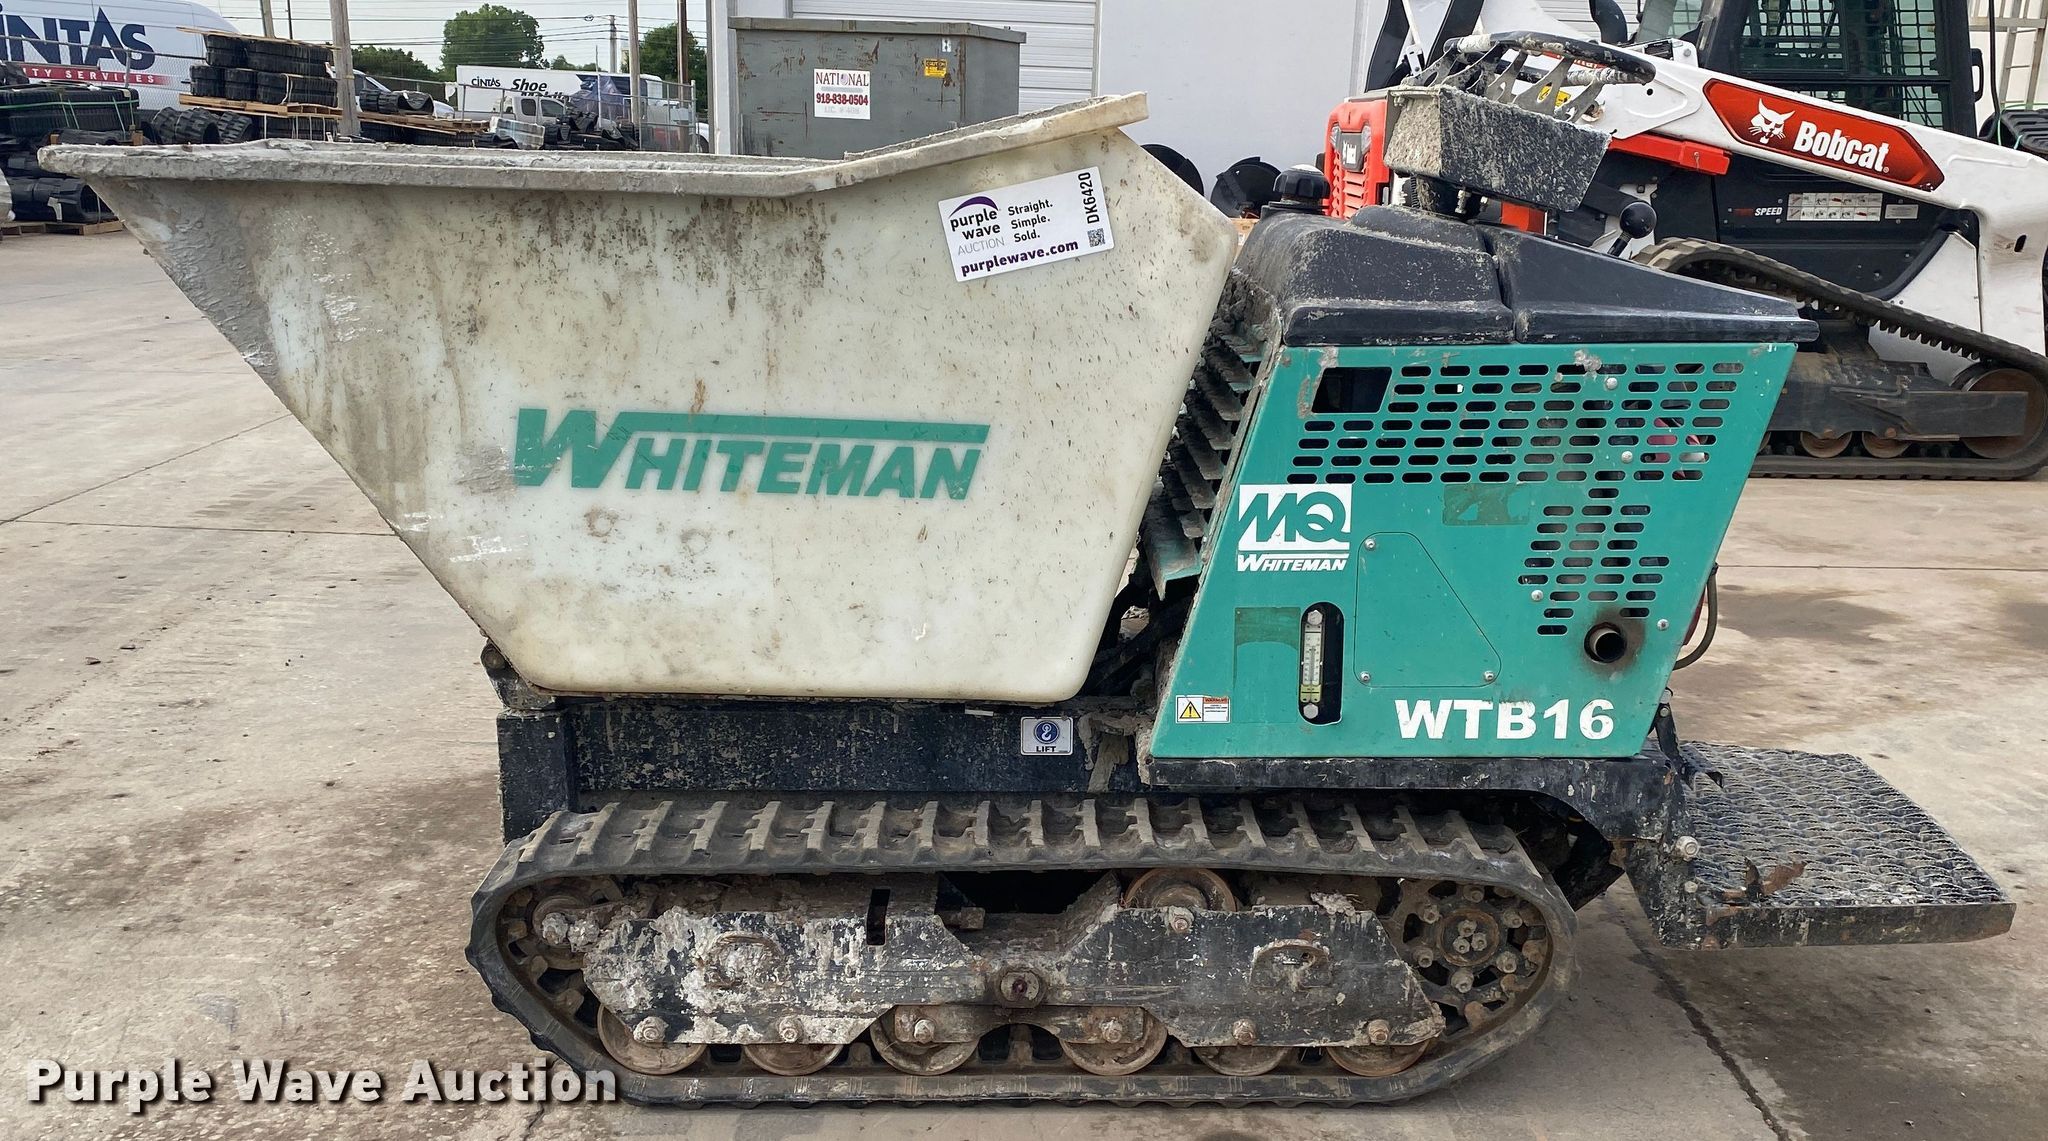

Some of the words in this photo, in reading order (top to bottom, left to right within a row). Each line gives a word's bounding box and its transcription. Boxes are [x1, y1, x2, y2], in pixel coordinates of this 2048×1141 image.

[65, 69, 155, 84] SERVIES
[511, 78, 548, 92] Shoe
[815, 72, 869, 87] NATIONAL
[816, 93, 869, 105] 918-838-0504
[1793, 120, 1890, 172] Bobcat
[1078, 172, 1100, 224] DK6420
[1007, 199, 1053, 217] Straight.
[1754, 206, 1783, 217] SPEED
[950, 208, 998, 232] purple
[1010, 214, 1051, 230] Simple.
[962, 222, 1001, 240] wave
[1013, 229, 1041, 243] Sold.
[957, 237, 1005, 256] AUCTION
[960, 240, 1079, 277] purplewave.com
[513, 408, 991, 501] WHITEMAN
[1238, 491, 1350, 543] MQ
[1237, 553, 1350, 572] WHITEMAN
[1394, 698, 1615, 740] WTB16
[1035, 745, 1057, 753] LIFT
